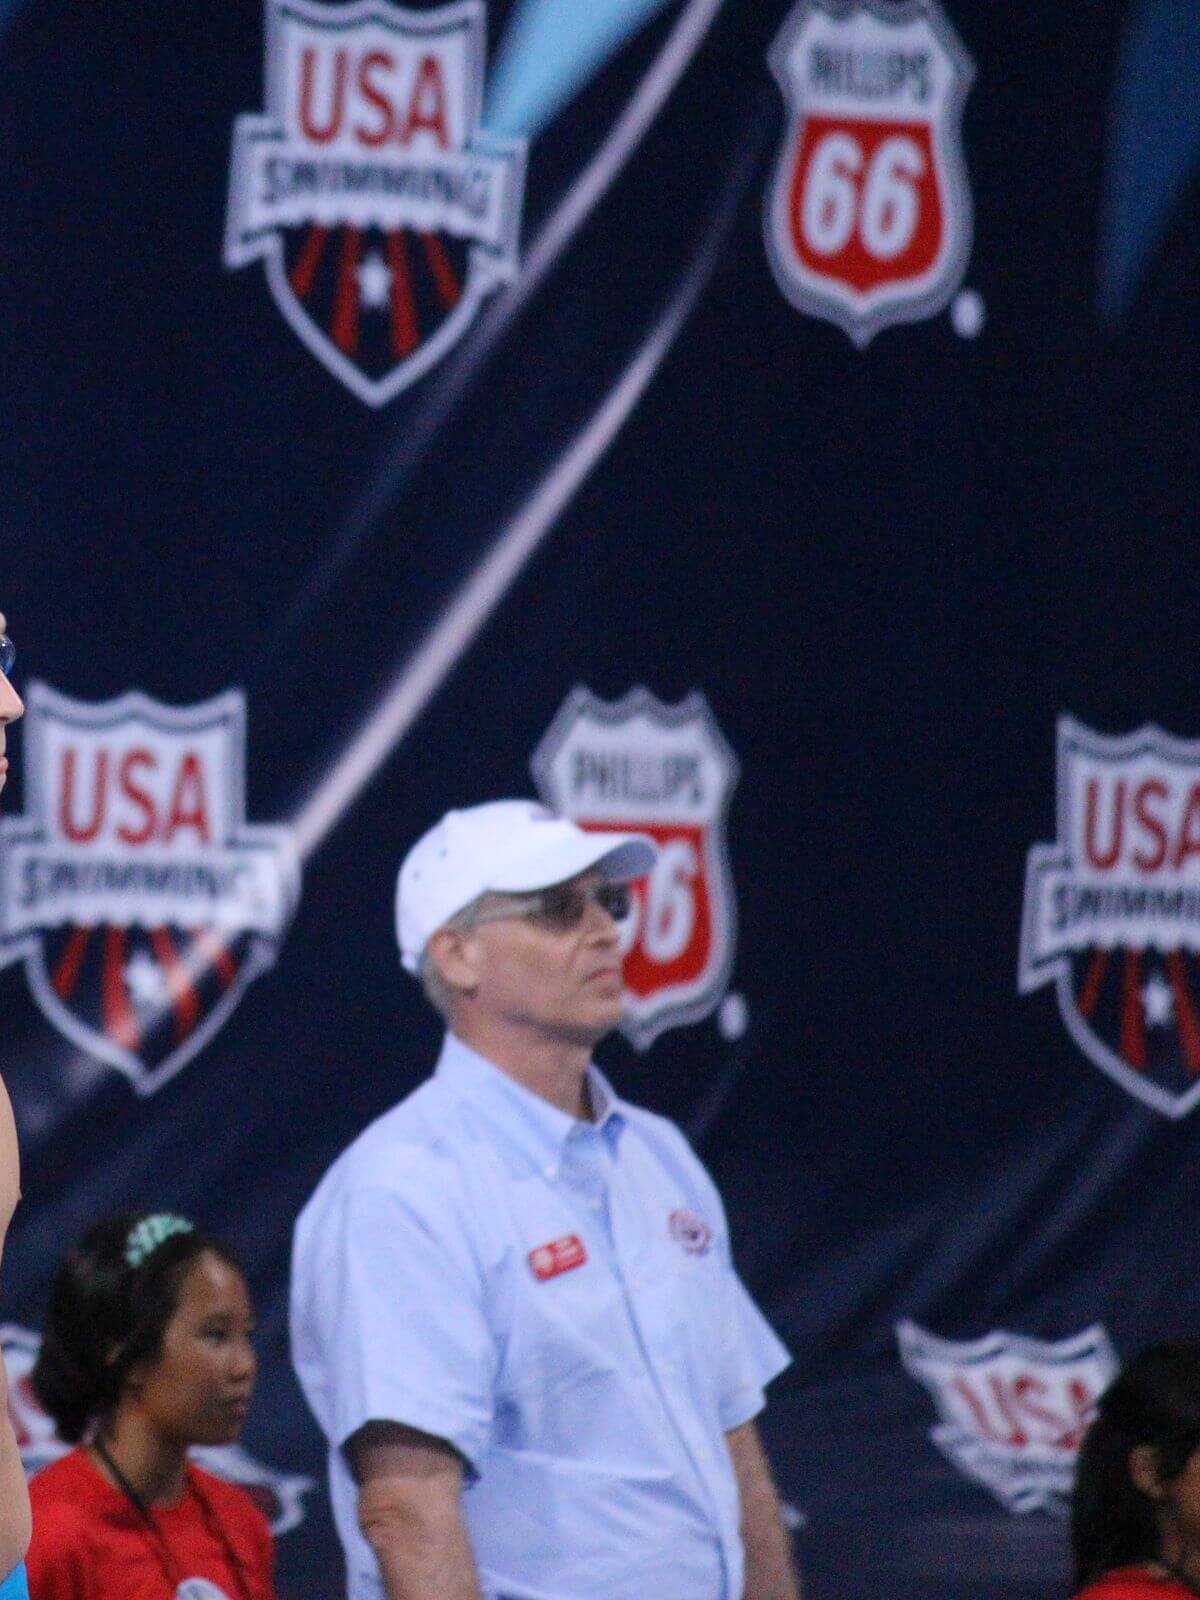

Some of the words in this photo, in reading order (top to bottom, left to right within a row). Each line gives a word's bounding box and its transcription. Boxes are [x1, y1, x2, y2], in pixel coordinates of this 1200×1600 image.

[299, 44, 450, 150] USA
[263, 156, 491, 218] SWIMMING
[802, 130, 924, 261] 66
[59, 747, 212, 846] USA
[22, 858, 252, 908] SWIMMIN
[616, 840, 698, 964] 6
